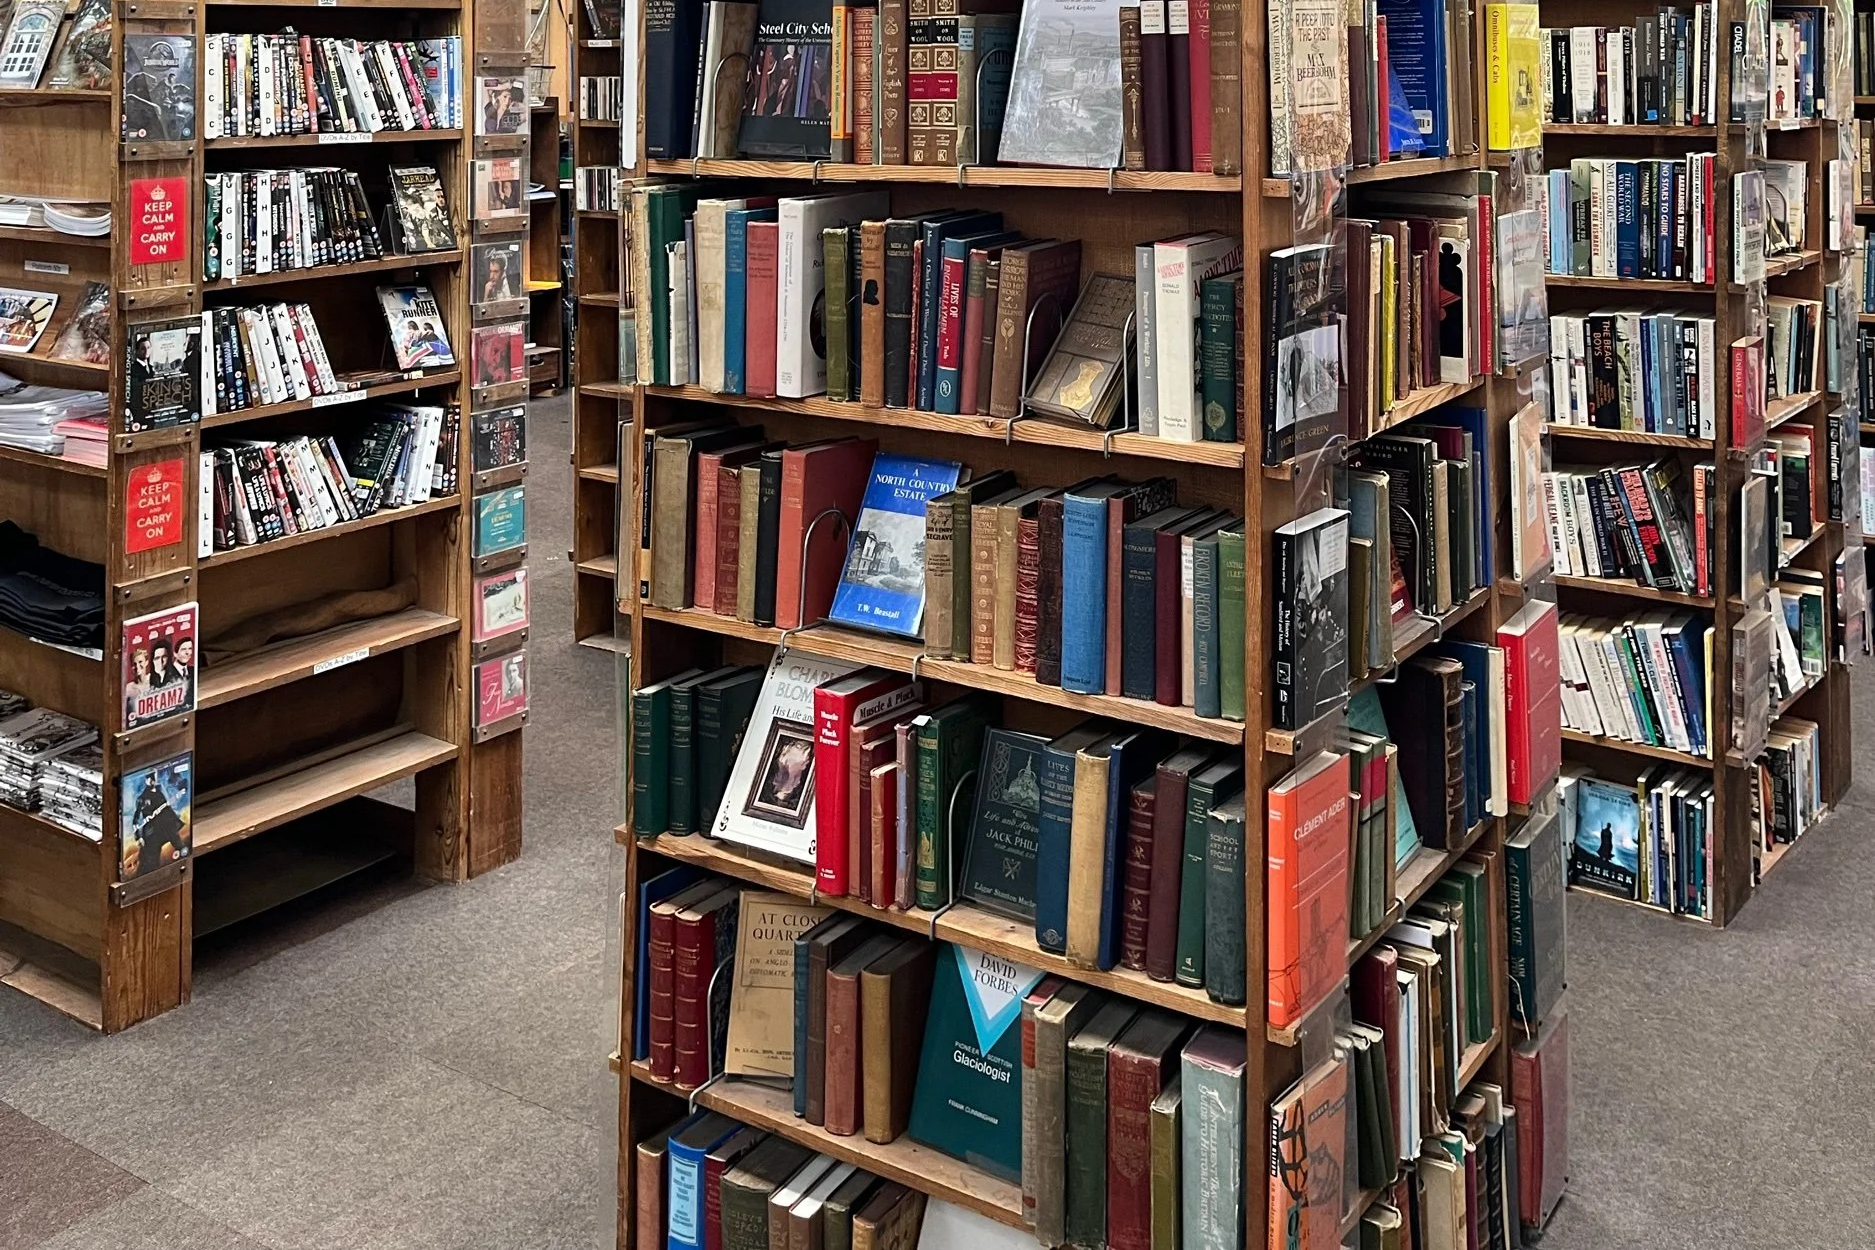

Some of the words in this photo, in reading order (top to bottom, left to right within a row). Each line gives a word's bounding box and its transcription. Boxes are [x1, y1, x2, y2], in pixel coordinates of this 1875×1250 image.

[935, 19, 955, 27] SMITH
[1271, 14, 1282, 35] MAX
[1295, 13, 1301, 25] A
[1301, 12, 1318, 27] PEEP
[759, 22, 785, 36] Steel
[786, 21, 809, 37] City
[1299, 26, 1312, 42] THE
[1312, 26, 1330, 42] PAST
[208, 42, 215, 50] C
[1574, 41, 1592, 49] 1914
[1733, 25, 1744, 54] CITADEL
[162, 56, 180, 67] WORLD
[1272, 35, 1283, 85] BEERBOHM
[208, 68, 215, 76] C
[1296, 66, 1337, 82] BEERBOHM
[330, 70, 343, 102] DOMINO
[208, 94, 215, 102] C
[208, 121, 215, 129] C
[1662, 164, 1670, 177] NO
[401, 173, 436, 185] JARHEAD
[1617, 173, 1625, 201] WORLD
[1624, 172, 1632, 188] THE
[1661, 177, 1670, 201] STARS
[144, 201, 173, 213] KEEP
[1624, 190, 1632, 225] SECOND
[1661, 202, 1669, 213] TO
[142, 212, 174, 224] CALM
[1660, 214, 1669, 237] GUIDE
[140, 231, 176, 243] CARRY
[149, 244, 167, 255] ON
[949, 282, 960, 304] LIVES
[415, 300, 435, 310] KITE
[949, 306, 960, 319] OF
[1204, 303, 1227, 311] PERCY
[401, 308, 437, 319] RUNNER
[1602, 320, 1611, 337] THE
[1593, 332, 1603, 357] BOYS
[1603, 339, 1613, 370] BEACH
[147, 377, 192, 396] KING'S
[142, 392, 192, 410] SPEECH
[204, 459, 210, 467] L
[912, 468, 920, 477] A
[140, 481, 170, 497] KEEP
[204, 486, 209, 494] L
[874, 473, 907, 488] NORTH
[907, 479, 952, 493] COUNTRY
[138, 494, 171, 509] CALM
[893, 488, 927, 501] ESTATE
[136, 512, 172, 529] CARRY
[1559, 480, 1571, 518] BACKROOM
[1566, 519, 1576, 546] BOYS
[146, 524, 164, 539] ON
[203, 539, 209, 547] L
[1195, 547, 1211, 588] BROKEN
[856, 602, 871, 614] T.W.
[873, 606, 901, 619] Beastall
[1195, 592, 1212, 633] RECORD
[1640, 642, 1652, 665] TUMULT
[1649, 670, 1660, 693] CLOUDS
[137, 686, 184, 716] DREAMZ
[859, 701, 886, 721] Muscle
[886, 697, 894, 709] &
[894, 689, 916, 705] Pluck
[771, 705, 787, 716] His
[786, 707, 803, 720] Life
[820, 710, 839, 721] Muscle
[819, 736, 841, 747] Forever
[821, 728, 837, 739] Pluck
[1047, 760, 1070, 773] LIVES
[1293, 809, 1329, 842] CLÉMENT
[1328, 797, 1346, 819] ADER
[986, 829, 1012, 845] JACK
[1209, 832, 1239, 846] SCHOOL
[1209, 849, 1232, 861] SPORT
[1575, 859, 1634, 885] DUNKIRK
[758, 912, 779, 926] AT
[764, 958, 788, 968] ANGLO
[979, 951, 1018, 979] DAVID
[974, 969, 1020, 997] FORBES
[954, 1040, 980, 1056] PIONEER
[953, 1048, 1012, 1085] Glaciologist
[1197, 1084, 1210, 1122] GUIDE
[1199, 1121, 1209, 1136] TO
[1199, 1136, 1209, 1187] HISTORIC
[1199, 1188, 1210, 1233] BRITAIN
